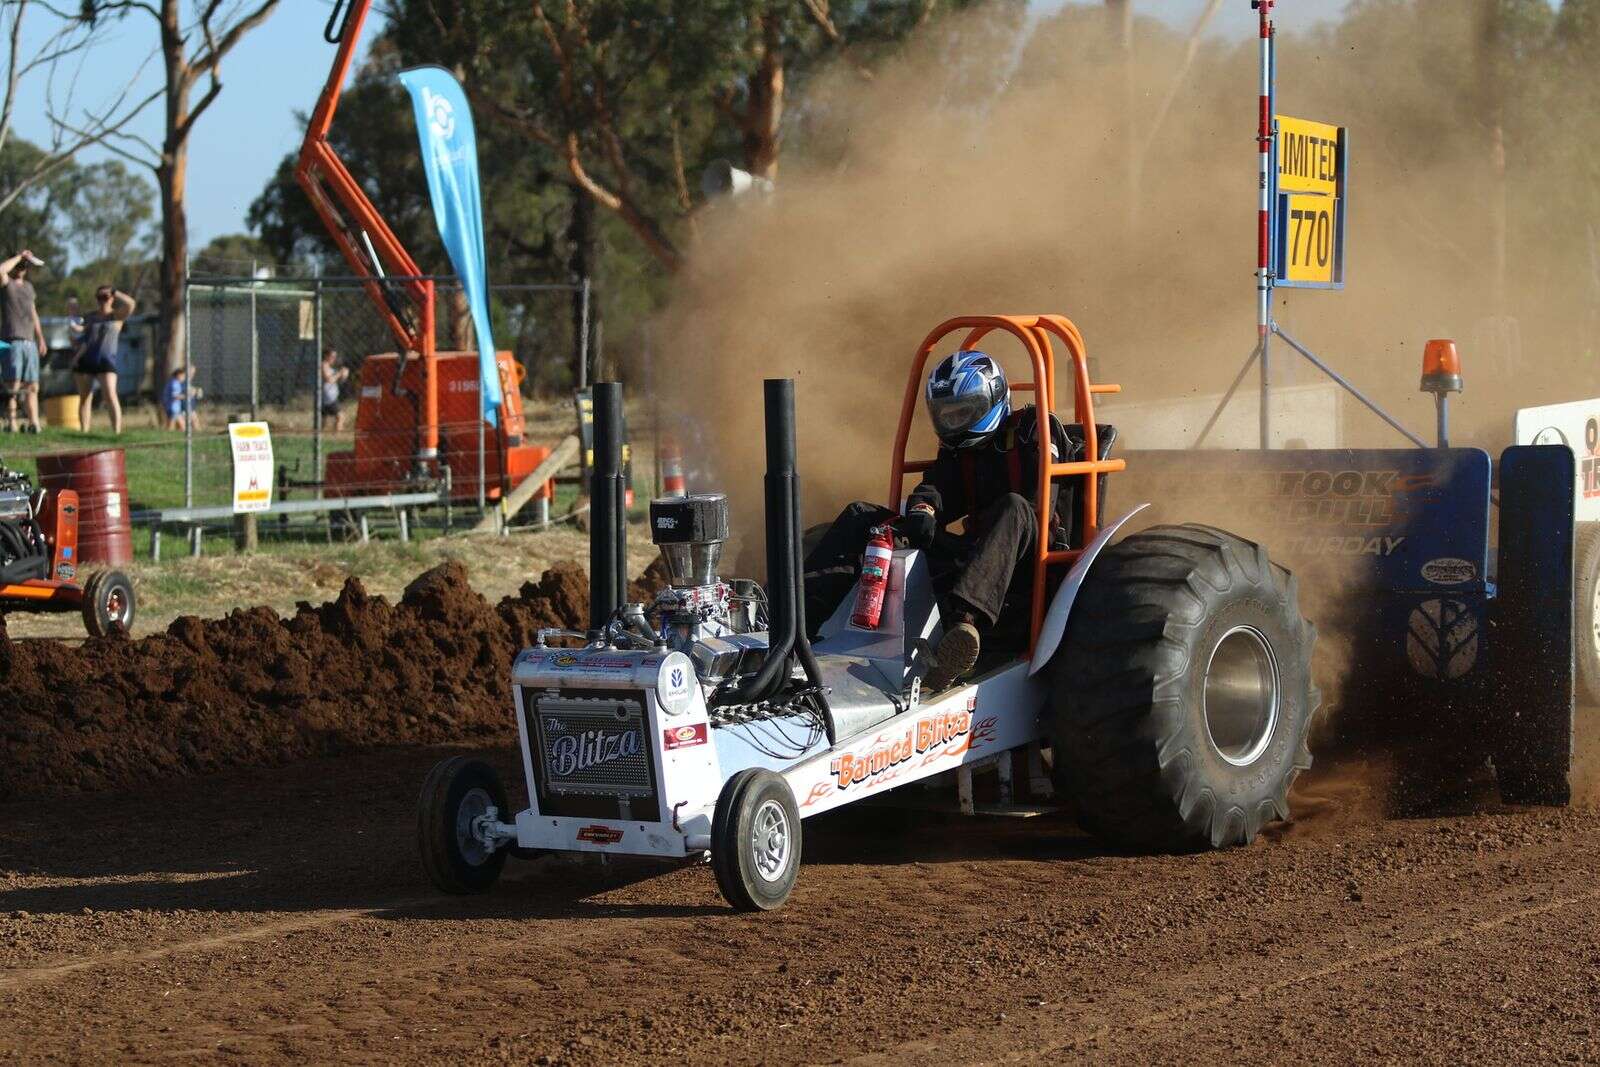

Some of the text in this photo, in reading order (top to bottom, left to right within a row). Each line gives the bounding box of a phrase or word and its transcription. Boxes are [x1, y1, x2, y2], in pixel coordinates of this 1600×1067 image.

[1279, 131, 1336, 182] IMITED
[1291, 209, 1330, 267] 770
[552, 729, 640, 776] Blitza
